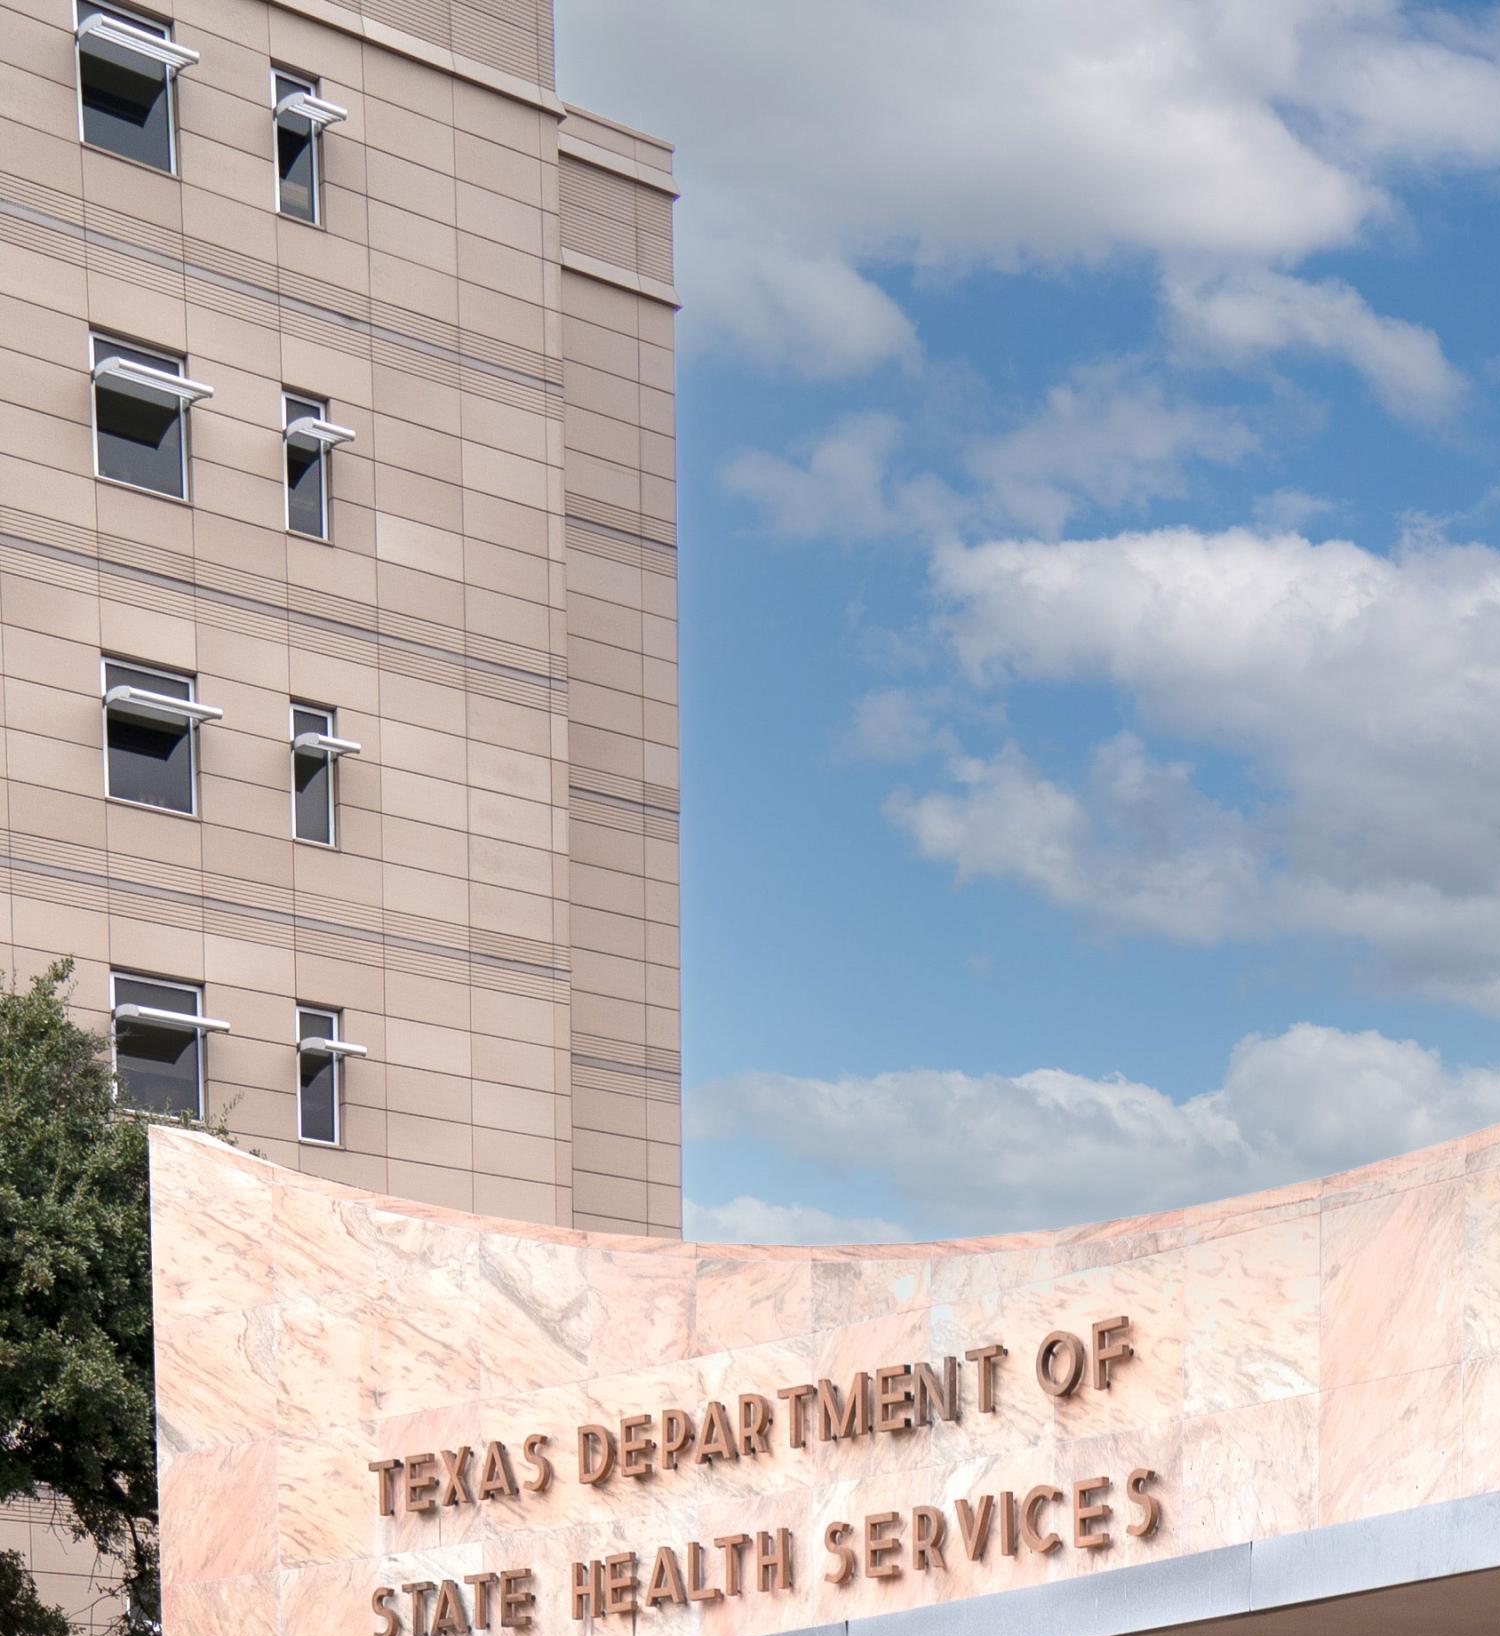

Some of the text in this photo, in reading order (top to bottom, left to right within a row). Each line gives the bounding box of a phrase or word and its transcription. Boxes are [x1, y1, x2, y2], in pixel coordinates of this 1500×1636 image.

[368, 1316, 1134, 1517] TEXAS DEPARTMENT OF
[572, 1527, 793, 1621] HEALTH
[824, 1467, 1161, 1586] SERVICES
